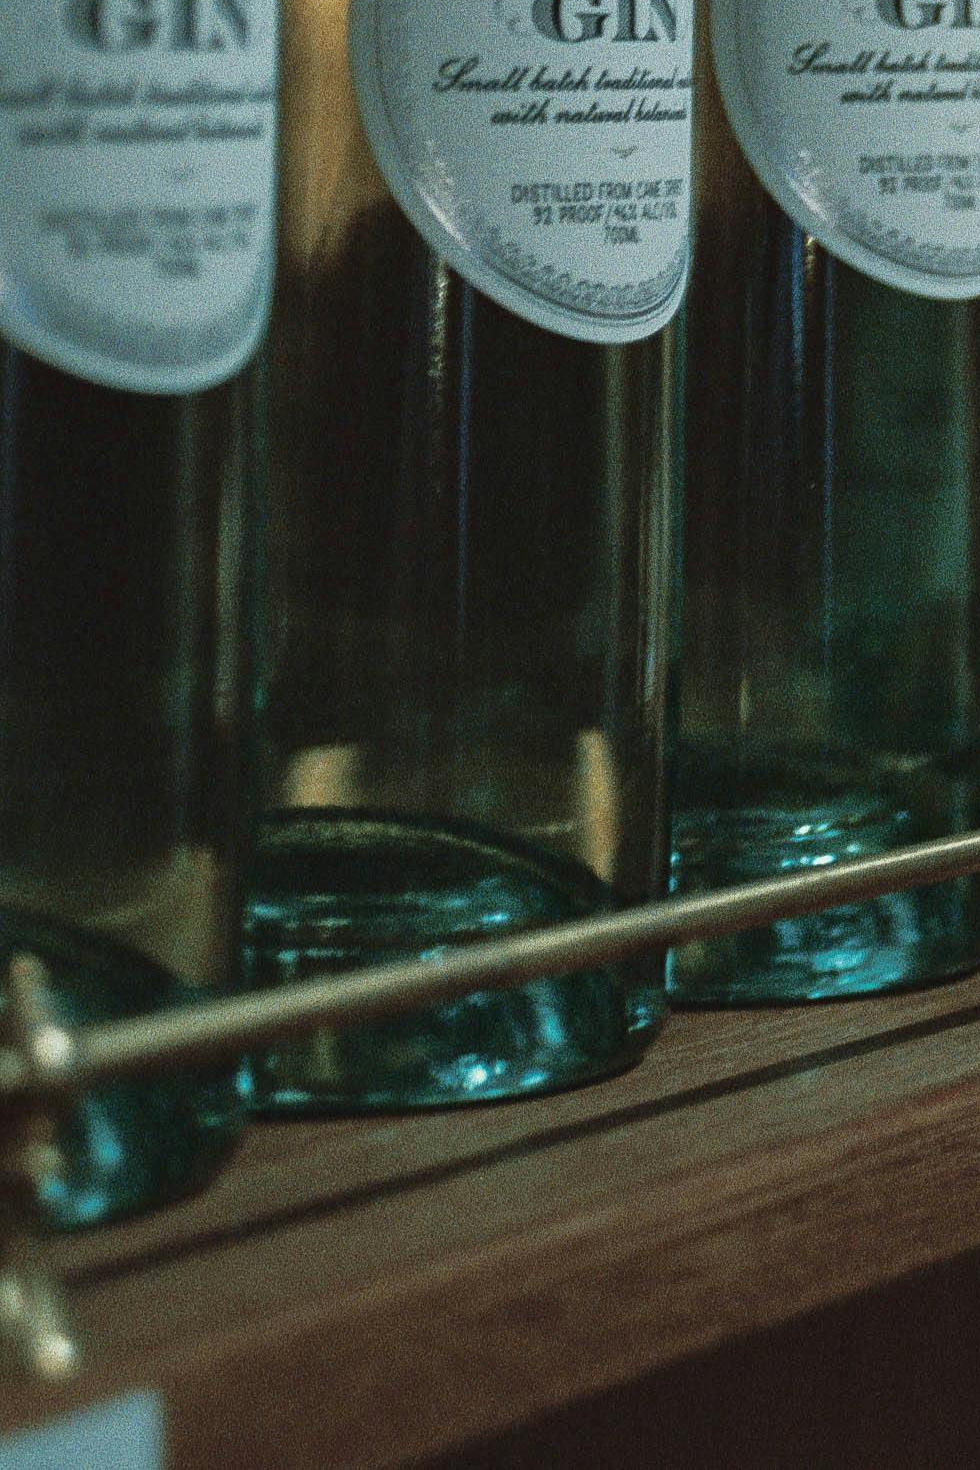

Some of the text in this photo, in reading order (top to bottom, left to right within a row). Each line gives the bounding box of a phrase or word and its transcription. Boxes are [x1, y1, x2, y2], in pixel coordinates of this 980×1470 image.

[433, 55, 528, 92] Small
[529, 65, 594, 92] batch
[491, 98, 551, 125] with
[510, 181, 594, 204] DISTILLED
